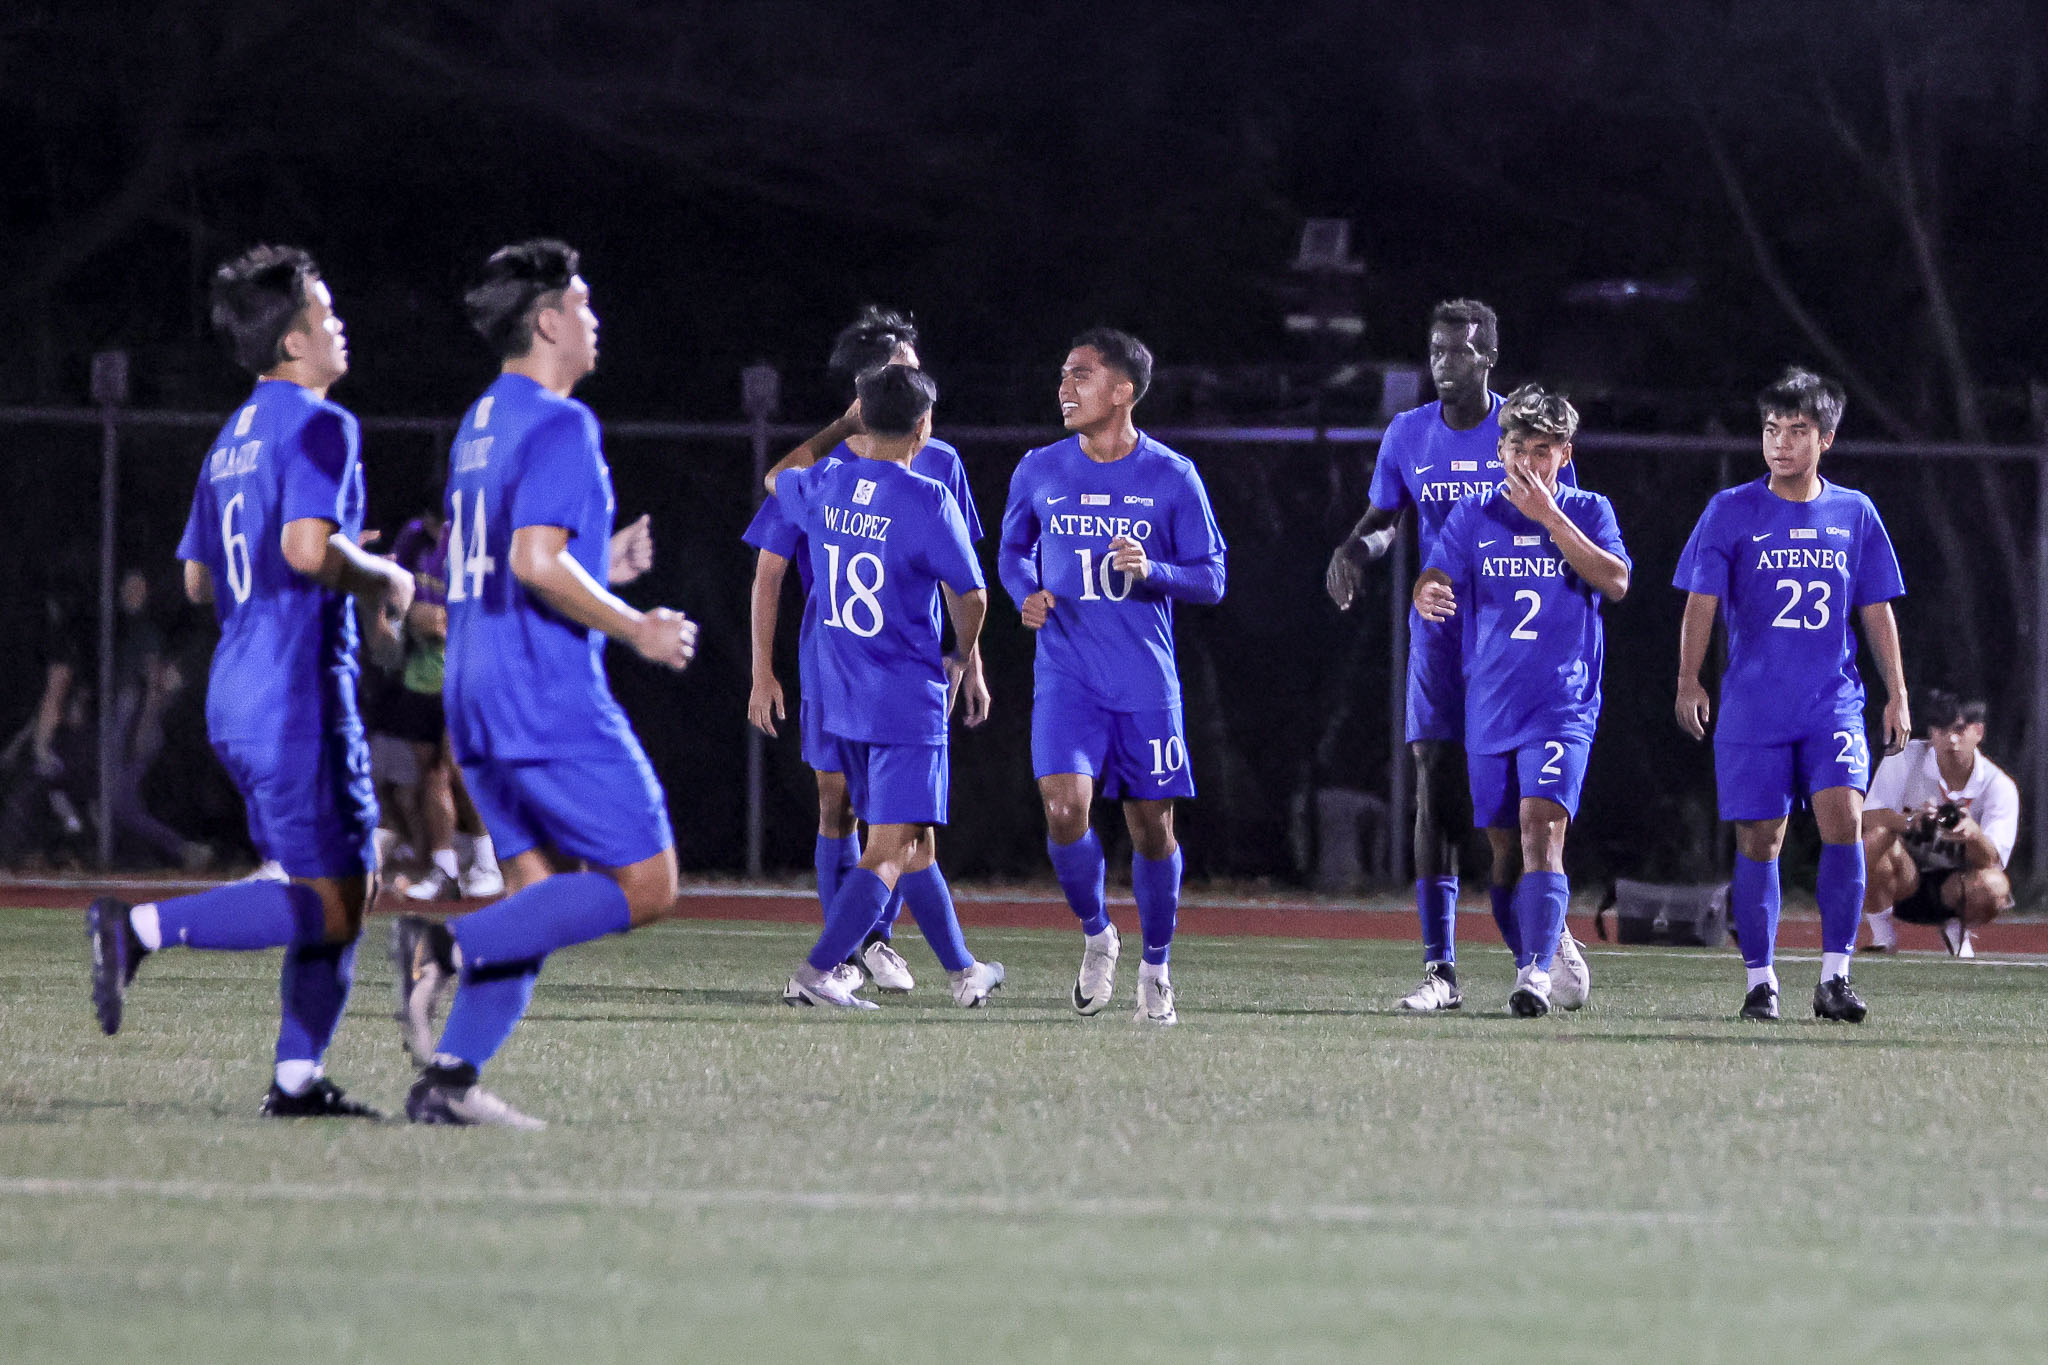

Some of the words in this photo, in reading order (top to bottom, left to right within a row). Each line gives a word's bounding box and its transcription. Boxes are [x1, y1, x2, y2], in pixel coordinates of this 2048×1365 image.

[222, 492, 252, 604] 6
[447, 488, 495, 603] 14
[1050, 514, 1152, 540] ATENEO
[1075, 548, 1134, 601] 10
[1757, 549, 1847, 571] ATENEO
[823, 543, 885, 638] 18
[1510, 589, 1541, 640] 2
[1772, 579, 1831, 630] 23
[1149, 736, 1184, 775] 10
[1541, 741, 1564, 775] 2
[1833, 731, 1868, 767] 23
